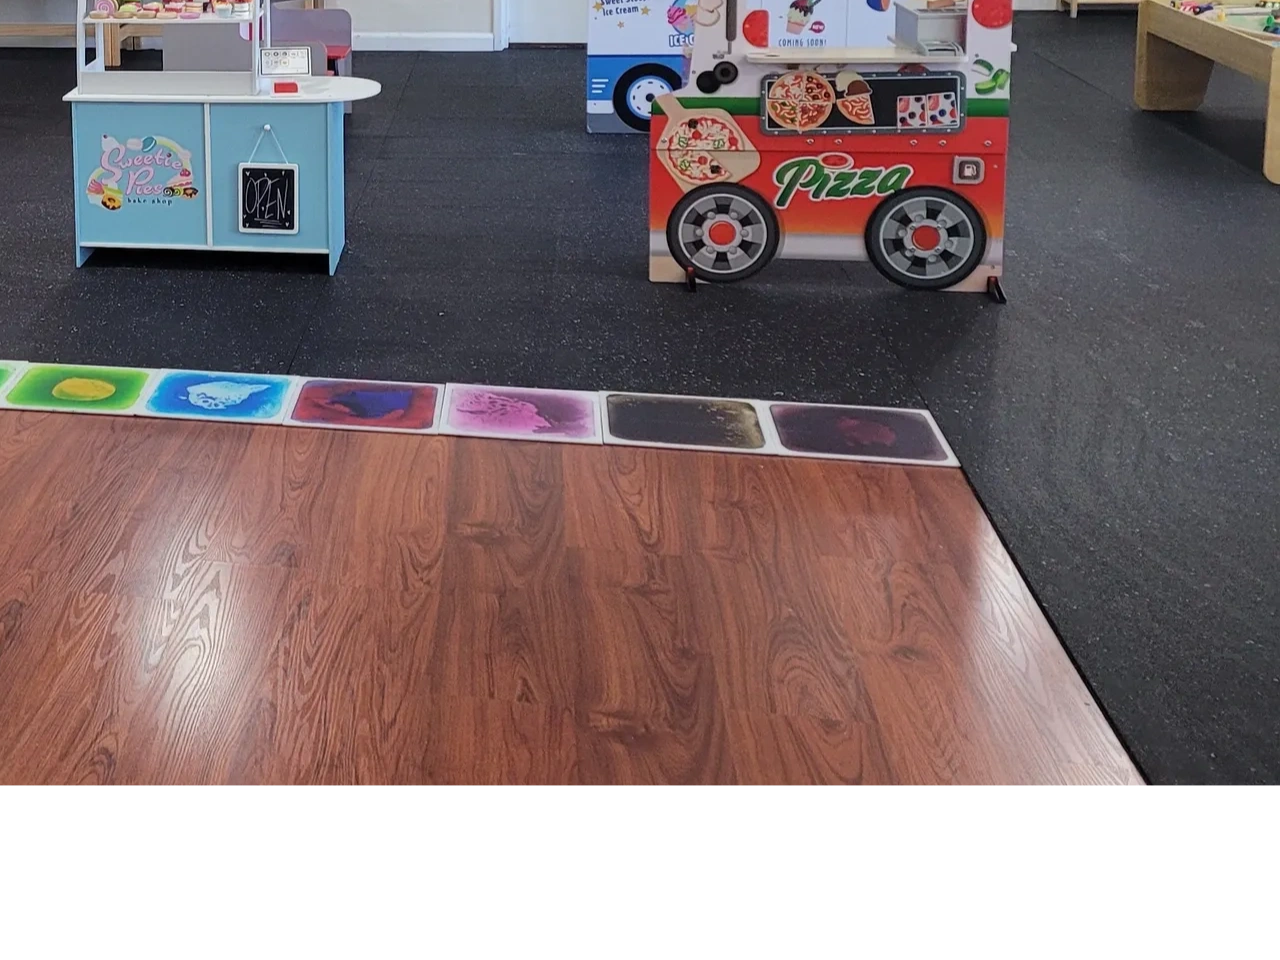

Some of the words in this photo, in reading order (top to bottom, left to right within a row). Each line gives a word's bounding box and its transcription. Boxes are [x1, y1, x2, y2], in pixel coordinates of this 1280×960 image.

[602, 7, 613, 16] Ice
[615, 6, 639, 15] Cream
[778, 38, 804, 47] COMING
[806, 38, 827, 47] SOON!
[101, 144, 184, 185] Sweetie
[125, 166, 164, 196] Pies
[773, 152, 914, 209] Pizza
[151, 197, 173, 206] shop
[245, 176, 289, 220] OPEN
